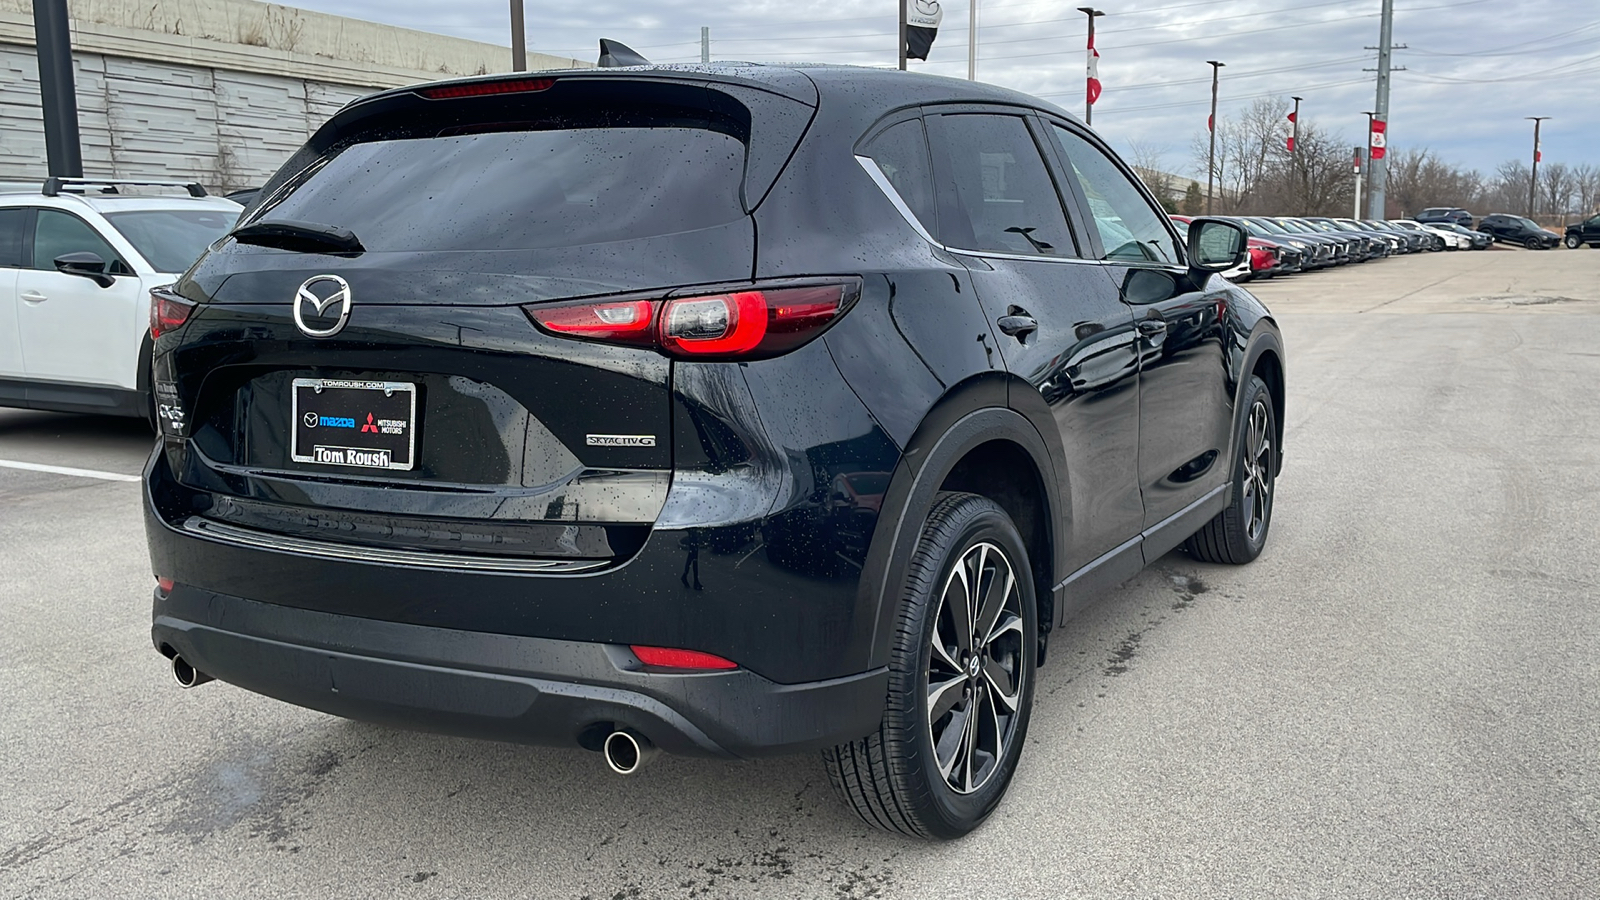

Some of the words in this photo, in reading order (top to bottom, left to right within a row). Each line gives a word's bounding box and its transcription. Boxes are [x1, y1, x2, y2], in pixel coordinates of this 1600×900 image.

[322, 380, 384, 389] TOMROUSH.COM
[319, 416, 355, 428] mazda
[377, 419, 407, 428] MITSUBISHI
[381, 427, 403, 435] MOTORS
[315, 447, 344, 463] Tom
[346, 449, 389, 467] Roush
